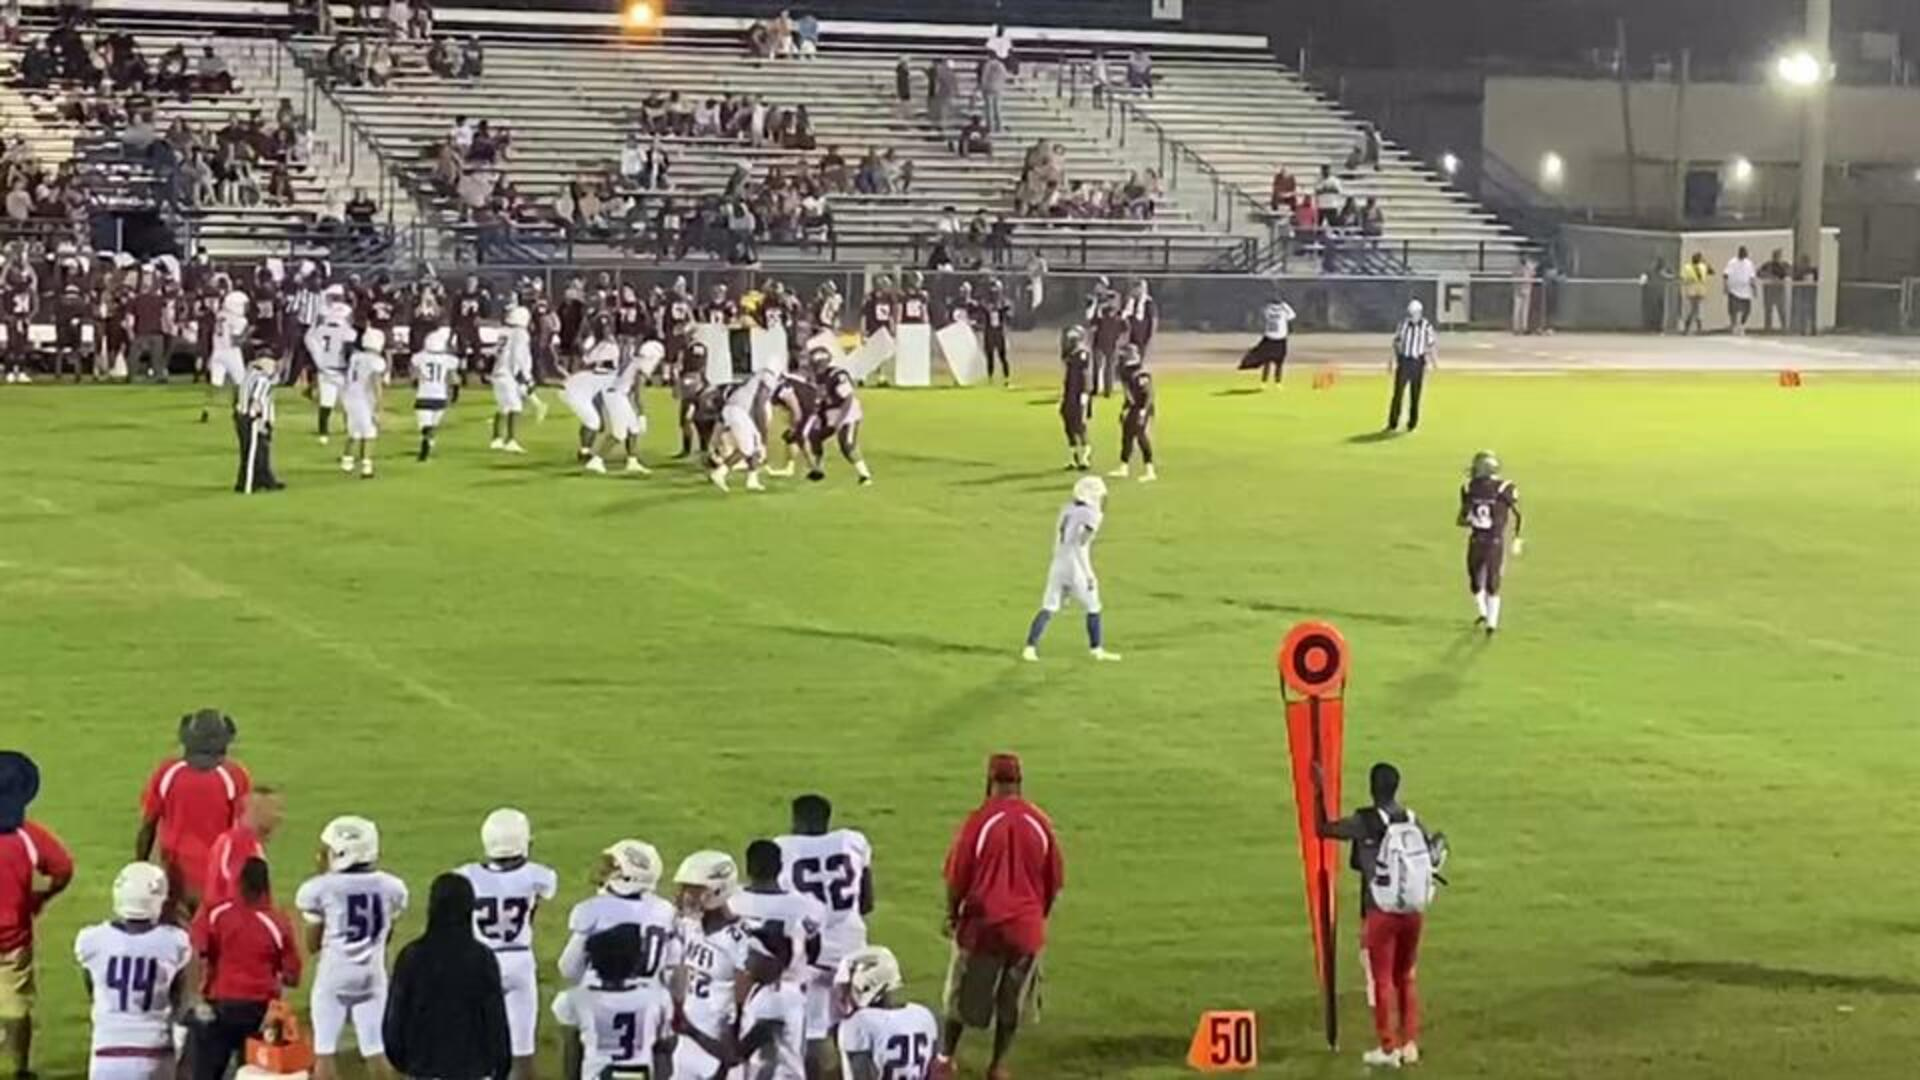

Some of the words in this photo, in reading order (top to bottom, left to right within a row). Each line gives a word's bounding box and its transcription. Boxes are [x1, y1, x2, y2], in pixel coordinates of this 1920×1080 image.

[1444, 283, 1467, 312] F
[346, 892, 385, 944] 51
[472, 897, 529, 942] 23
[106, 955, 158, 1012] 44
[612, 1011, 636, 1061] 3
[1211, 1017, 1253, 1065] 50
